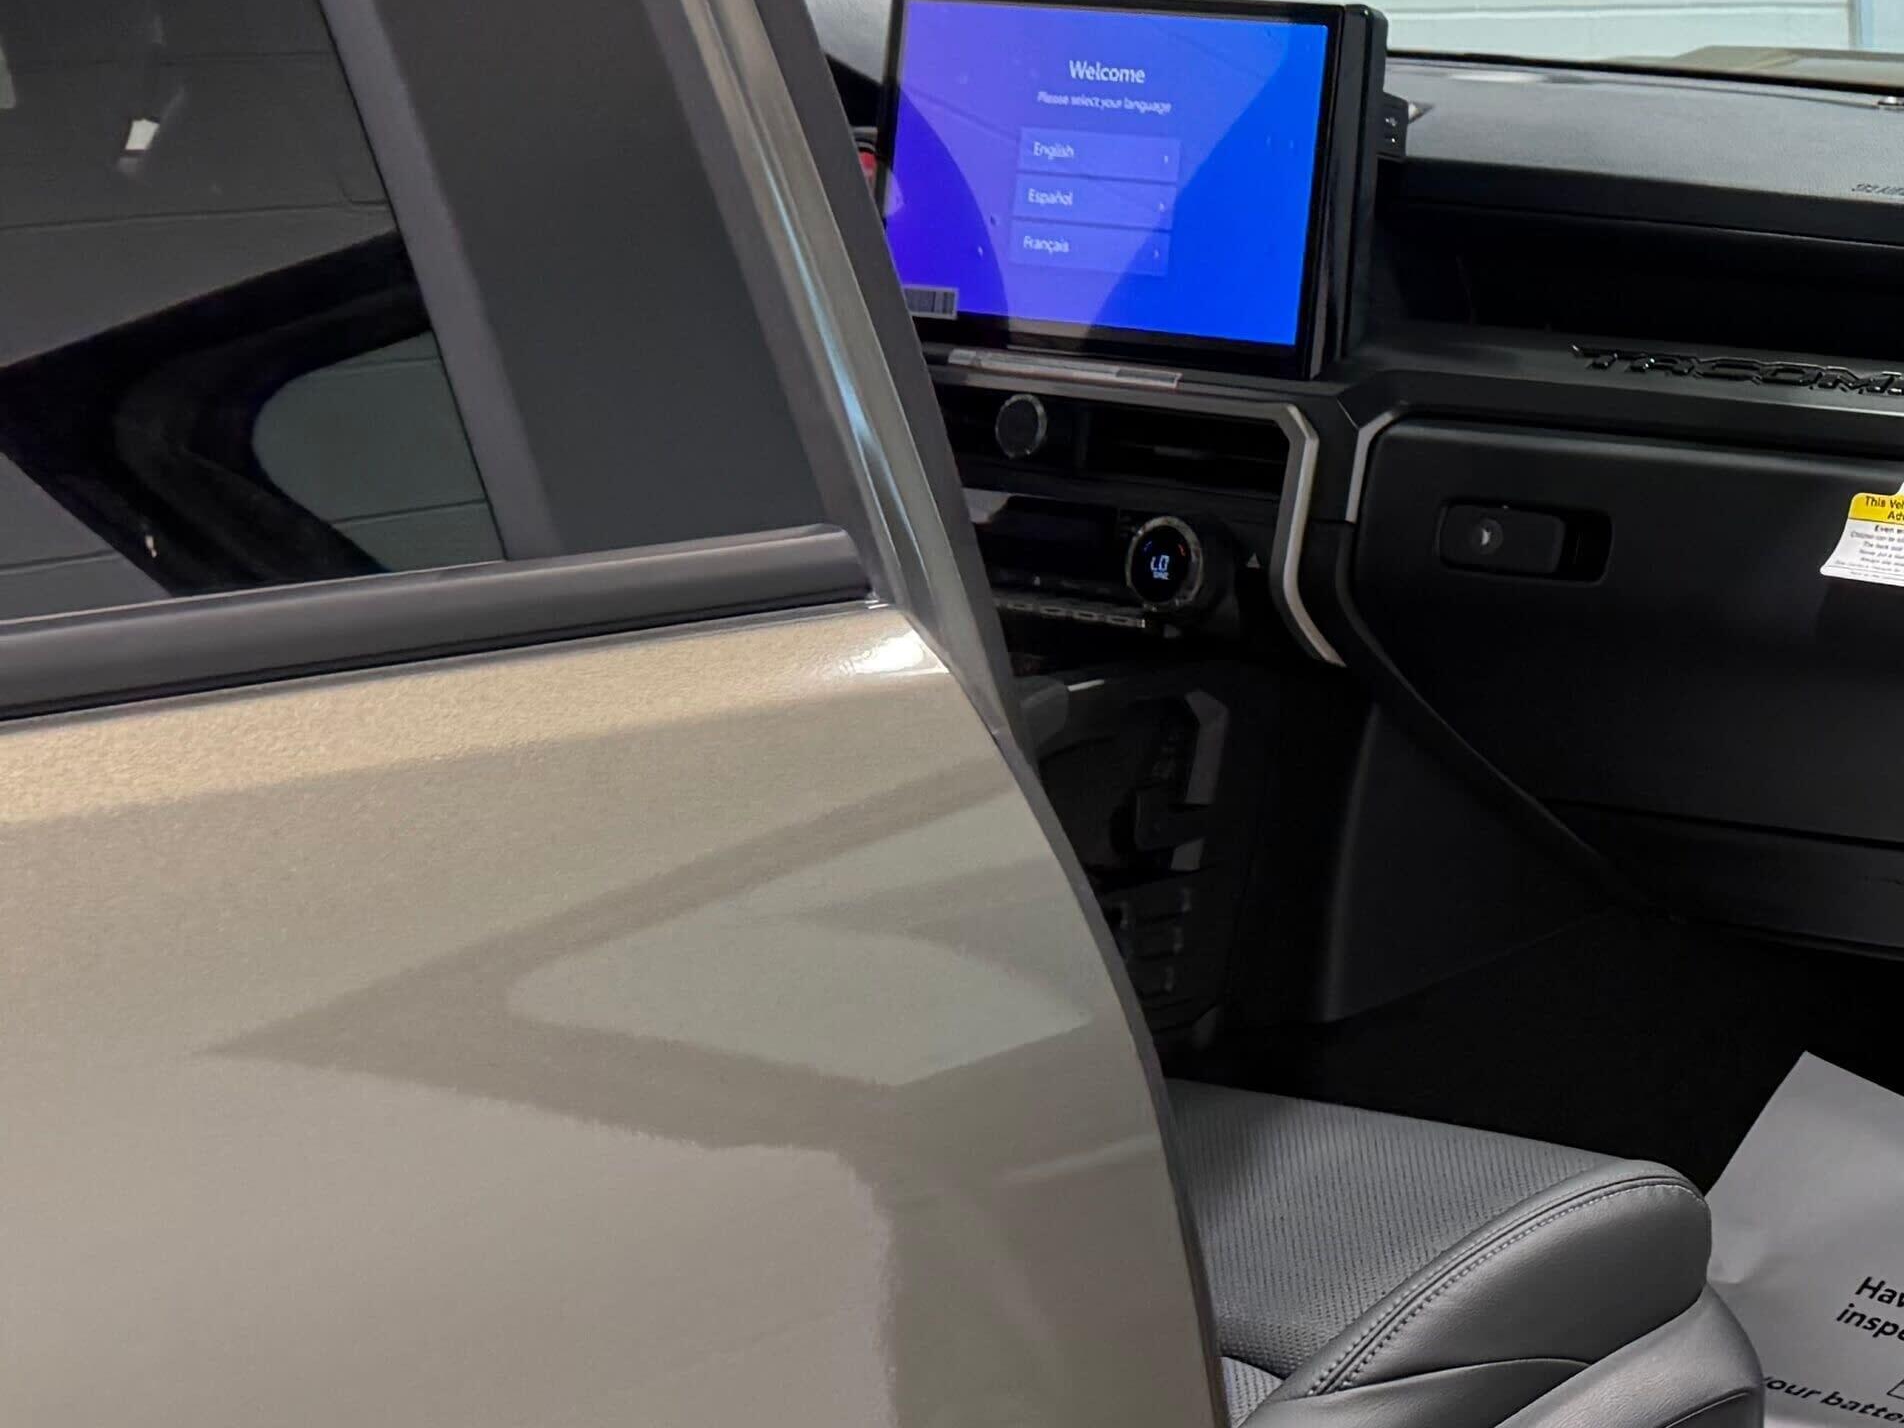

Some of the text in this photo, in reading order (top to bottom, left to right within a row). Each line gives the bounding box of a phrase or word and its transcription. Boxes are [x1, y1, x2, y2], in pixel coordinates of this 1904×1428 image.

[1069, 59, 1146, 84] Welcome
[1037, 91, 1069, 105] Please
[1124, 97, 1172, 115] language
[1033, 141, 1075, 160] English
[1027, 188, 1073, 207] Español
[1023, 235, 1069, 255] Français
[1864, 495, 1886, 508] This
